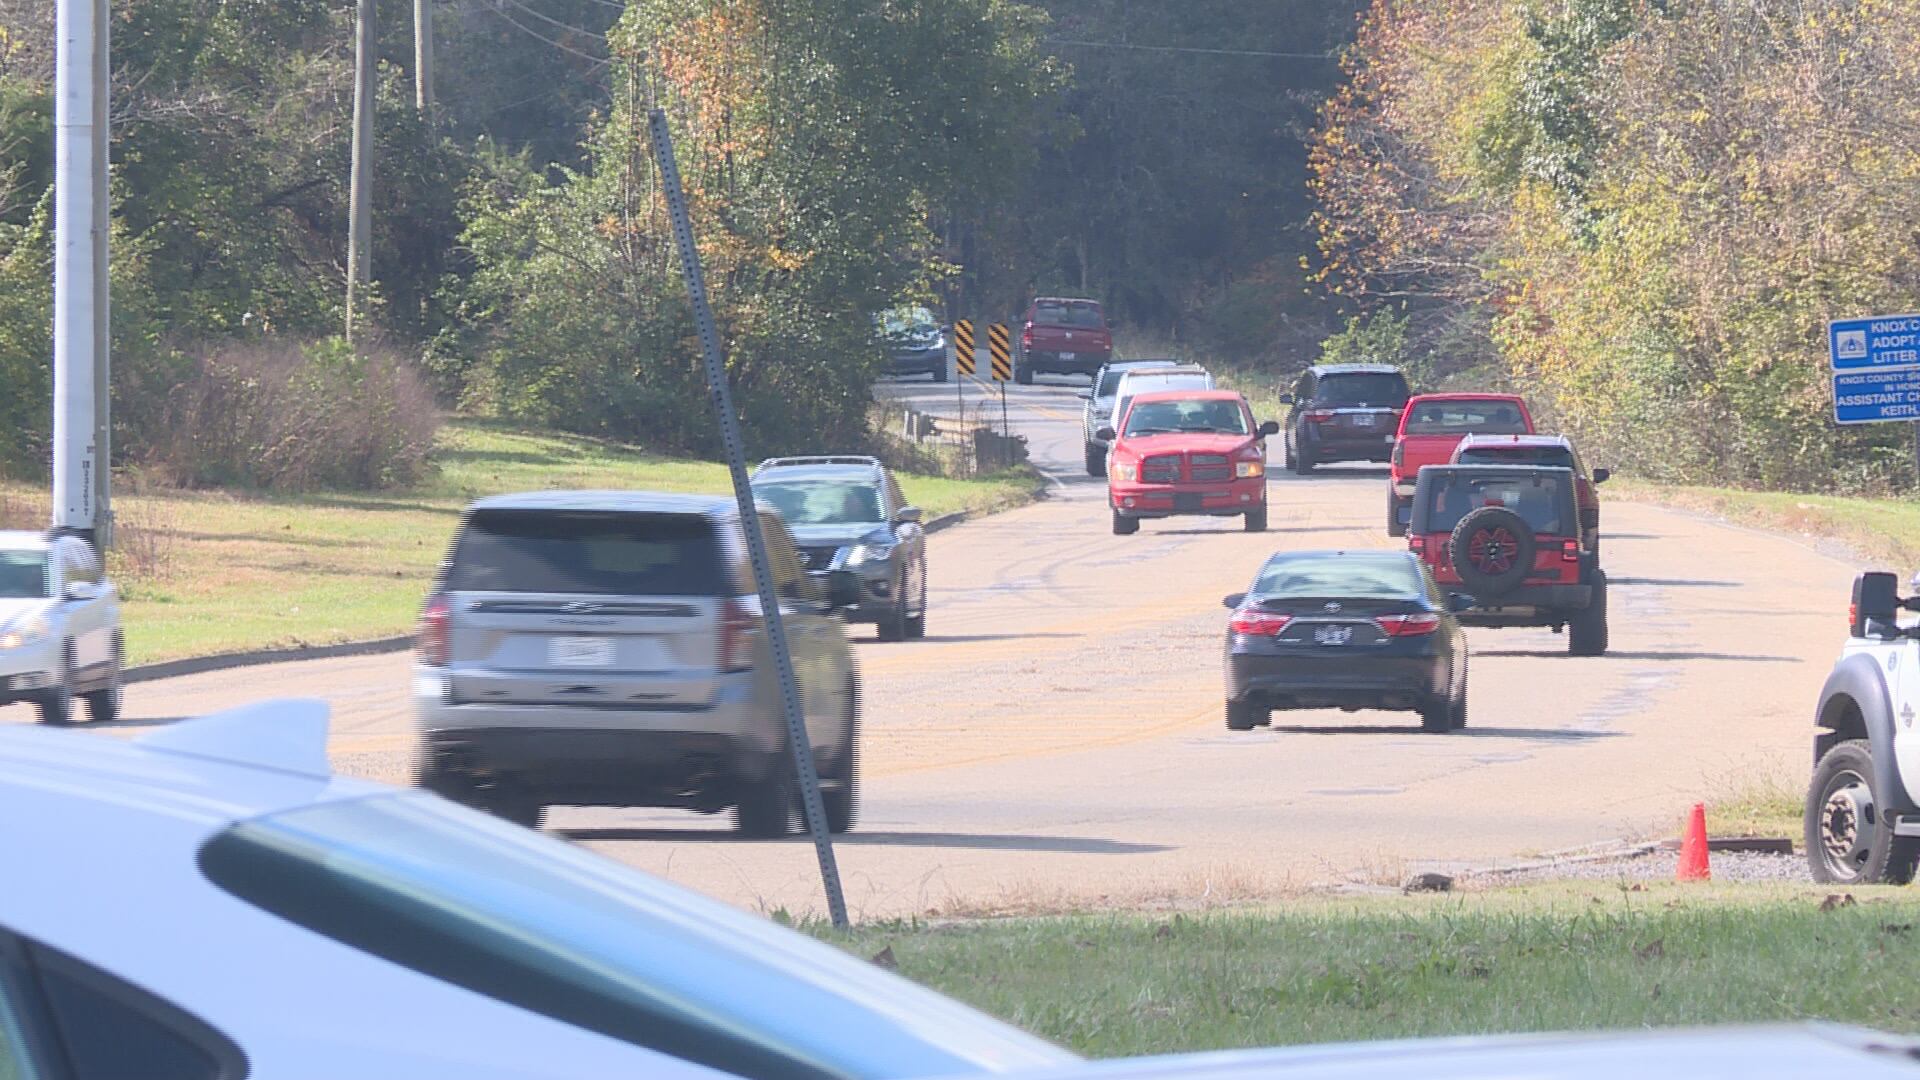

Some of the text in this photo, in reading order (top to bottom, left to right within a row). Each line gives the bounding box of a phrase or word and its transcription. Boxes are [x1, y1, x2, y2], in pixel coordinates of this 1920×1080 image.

[1872, 320, 1908, 333] KNOX
[1872, 335, 1916, 349] ADOPT
[1873, 350, 1918, 364] LITTER
[1840, 376, 1865, 385] KNOX
[1866, 374, 1905, 384] COUNTY
[1884, 384, 1894, 392] IN
[1838, 393, 1904, 407] ASSISTANT
[1880, 404, 1916, 417] KEITH
